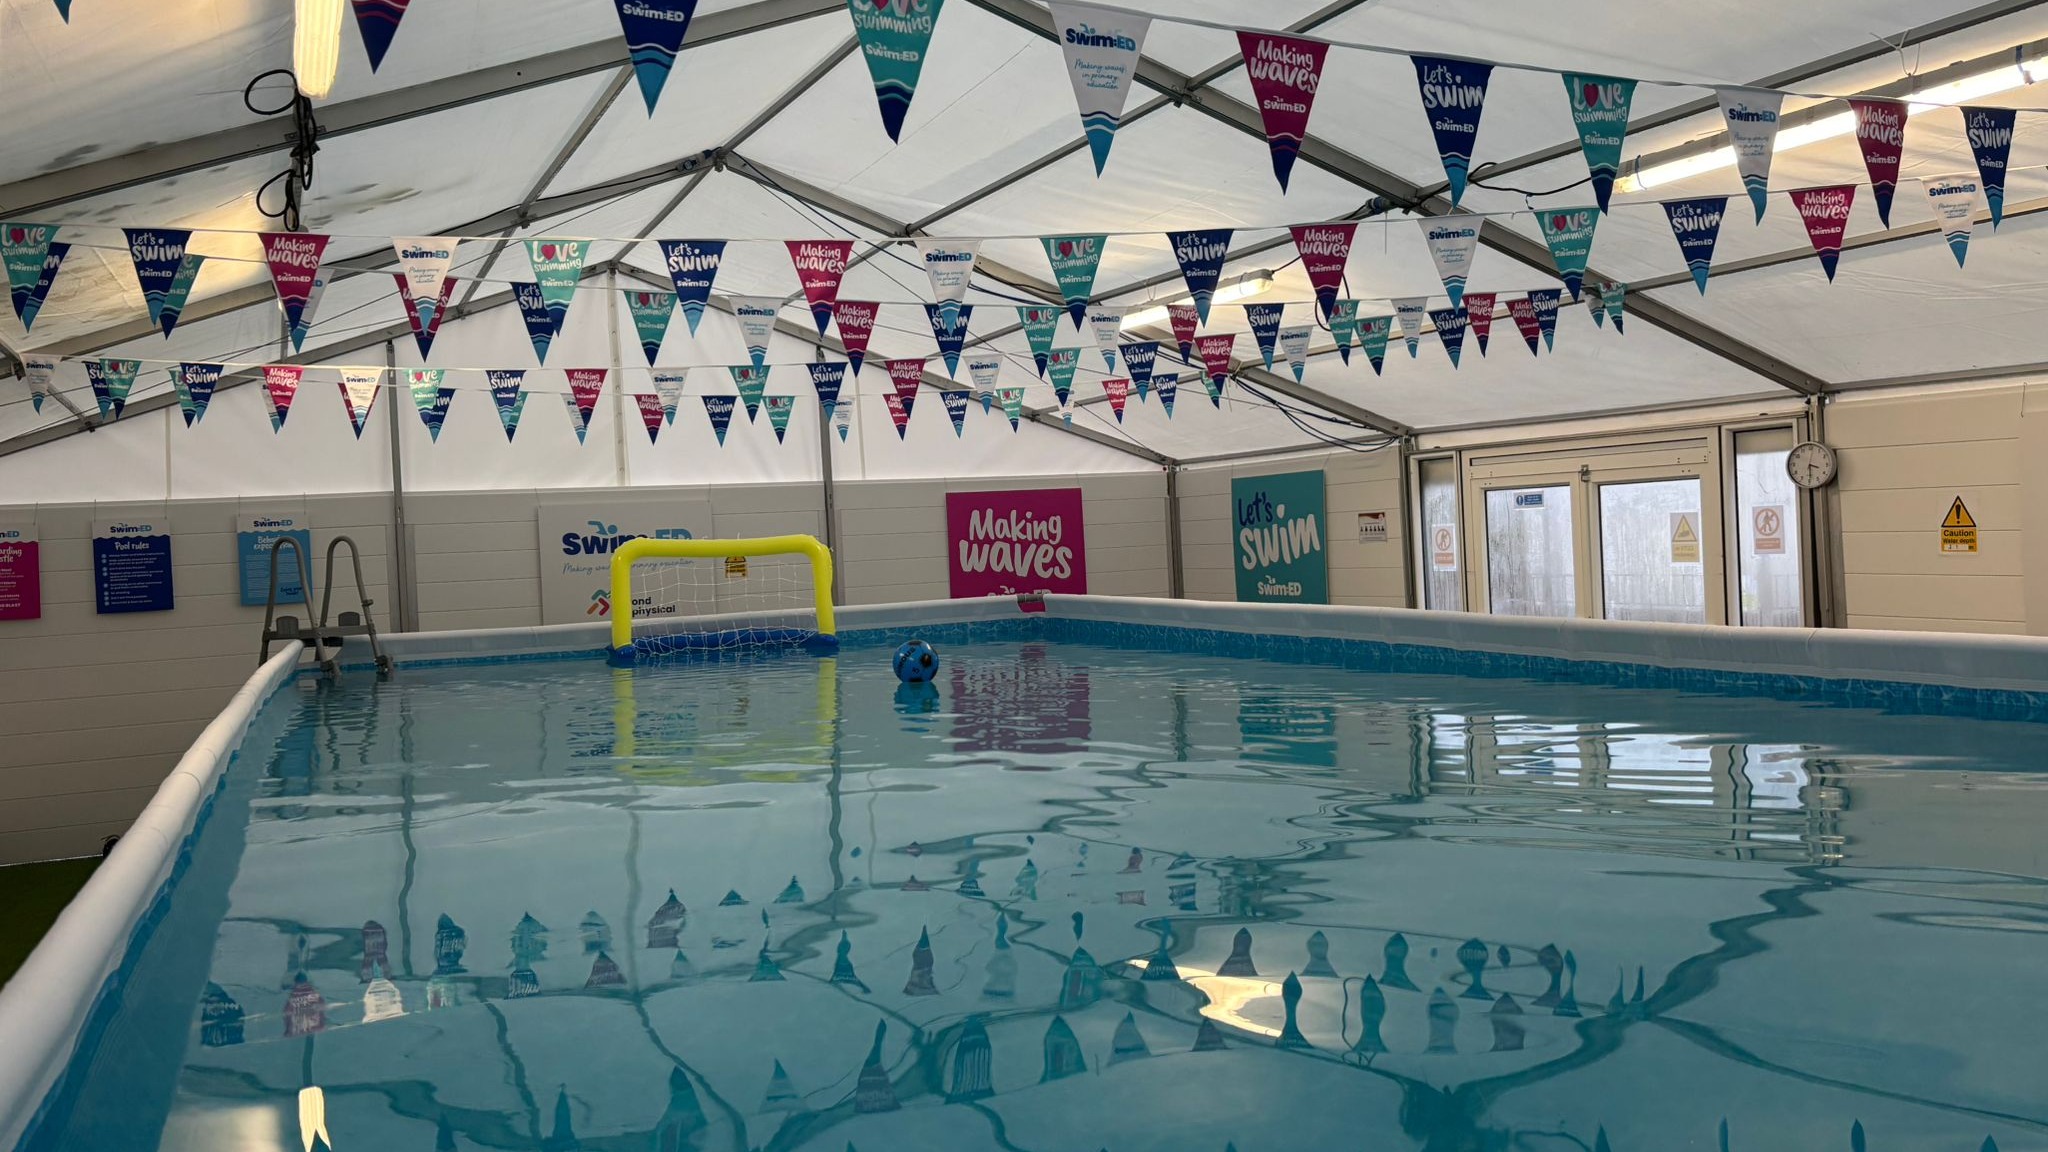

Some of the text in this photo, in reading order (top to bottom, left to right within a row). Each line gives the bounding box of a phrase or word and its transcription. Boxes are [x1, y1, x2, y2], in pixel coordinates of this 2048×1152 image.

[854, 12, 931, 34] swimming
[1066, 28, 1136, 51] Swim:ED
[1257, 40, 1312, 70] Making
[1250, 58, 1318, 94] waves
[1424, 66, 1452, 83] Let's
[1423, 75, 1484, 110] swim
[1574, 106, 1627, 123] swimming
[1860, 106, 1898, 128] Making
[1969, 114, 1989, 128] Let's
[1856, 123, 1904, 147] waves
[1969, 120, 2010, 150] swim
[1804, 192, 1845, 206] Making
[1670, 205, 1693, 218] Let's
[1800, 204, 1849, 220] waves
[1672, 207, 1723, 234] swim
[133, 233, 156, 245] Let's
[1176, 234, 1199, 248] Let's
[1304, 229, 1344, 244] Making
[1547, 226, 1593, 244] swimming
[3, 243, 47, 256] swimming
[132, 238, 186, 262] swim
[273, 237, 316, 255] Making
[668, 244, 692, 256] Let's
[800, 244, 841, 261] Making
[1178, 238, 1226, 264] swim
[1300, 242, 1349, 258] waves
[268, 249, 319, 270] waves
[534, 258, 582, 272] swimming
[668, 248, 720, 272] swim
[796, 256, 845, 274] waves
[1052, 254, 1098, 270] swimming
[840, 304, 871, 317] Making
[1468, 304, 1493, 316] waves
[836, 312, 874, 329] waves
[1201, 345, 1231, 356] waves
[267, 376, 298, 388] waves
[574, 372, 600, 382] Making
[891, 370, 921, 380] waves
[571, 379, 602, 391] waves
[1238, 492, 1273, 526] Let's
[969, 508, 1062, 545] Making
[1240, 504, 1320, 570] swim
[115, 542, 149, 550] Pool rules
[959, 540, 1072, 579] waves
[563, 562, 592, 575] Making
[632, 605, 676, 617] physical
